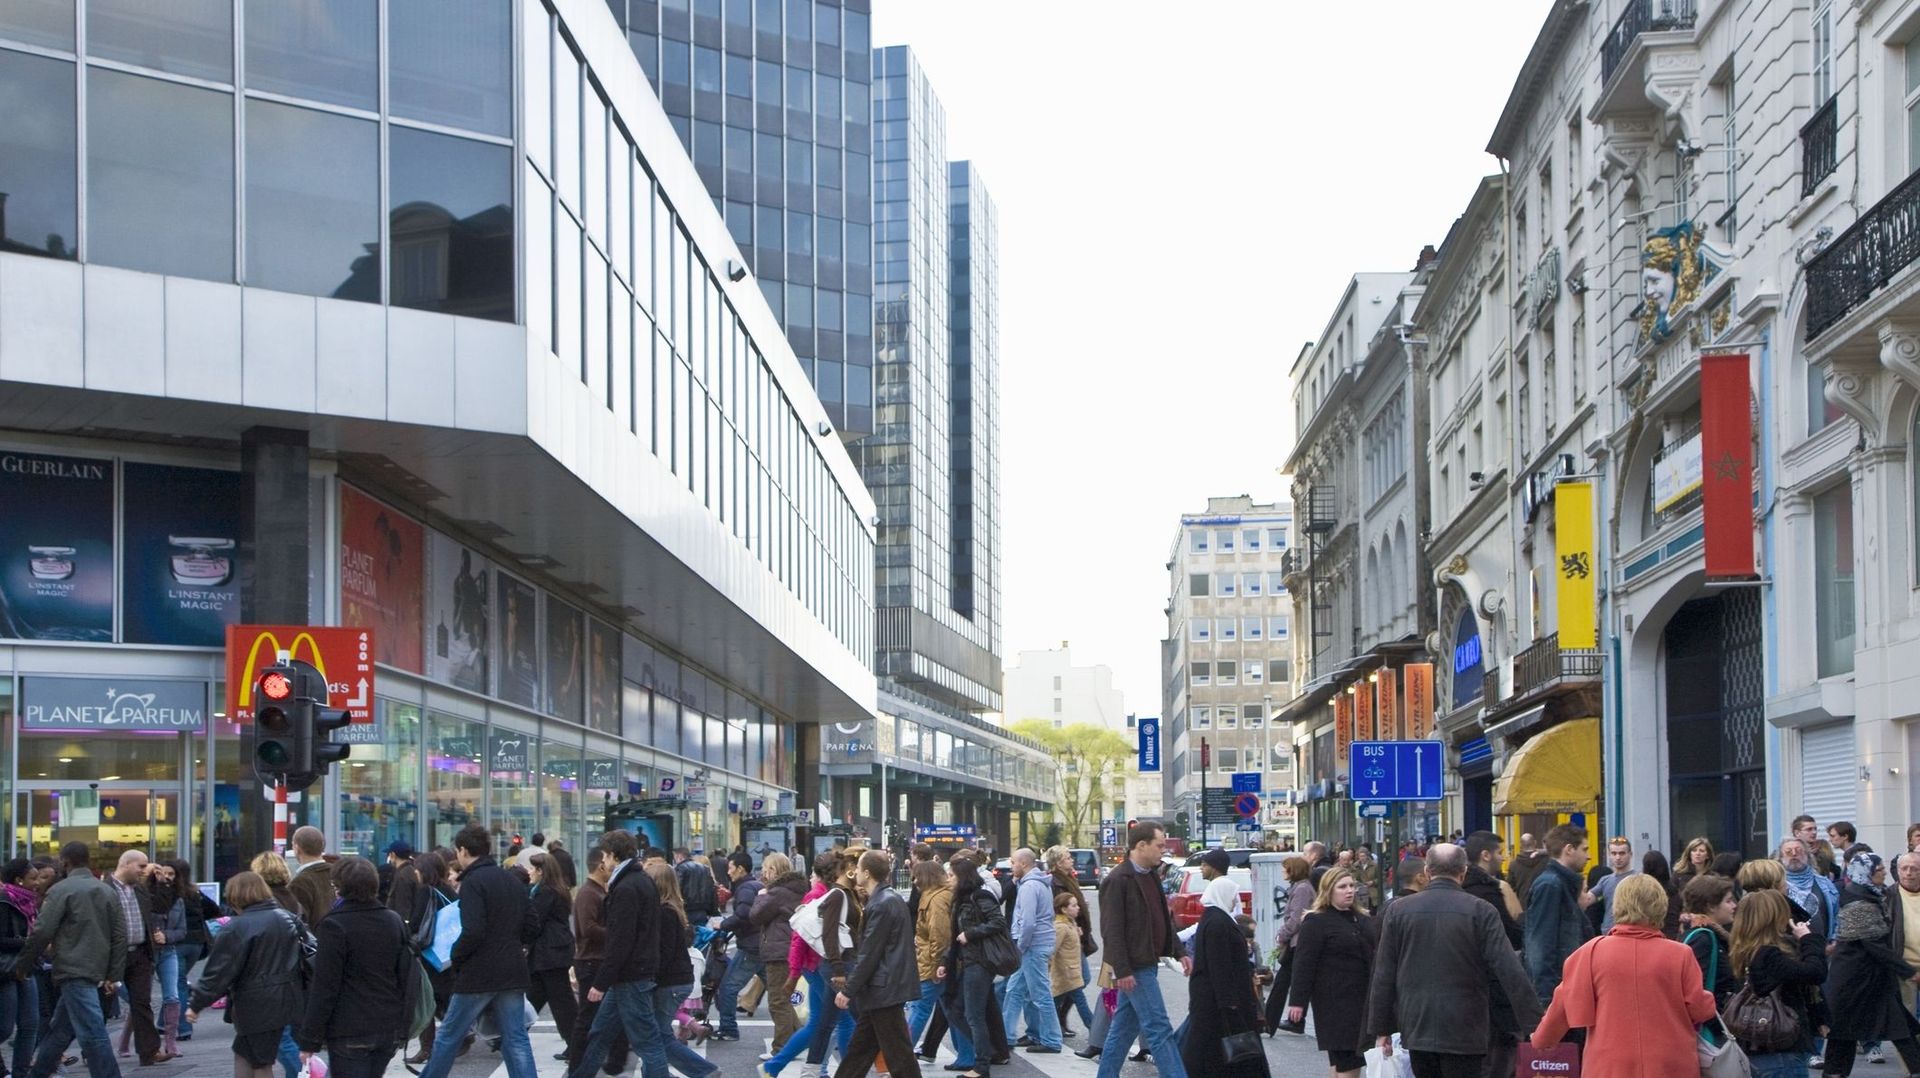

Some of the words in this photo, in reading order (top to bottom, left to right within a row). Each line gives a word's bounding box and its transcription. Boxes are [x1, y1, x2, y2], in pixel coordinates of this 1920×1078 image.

[2, 455, 103, 479] GUERLAIN
[342, 544, 374, 576] PLANET
[28, 582, 75, 590] L'INSTANT
[342, 566, 377, 600] PARFUM
[36, 589, 67, 597] MAGIC
[168, 589, 235, 601] L'INSTANT
[180, 600, 223, 610] MAGIC
[27, 706, 106, 723] PLANET
[122, 707, 202, 725] PARFUM
[338, 724, 378, 732] PLANET
[337, 732, 379, 741] PARFUM
[826, 743, 873, 751] PARTENA
[1145, 735, 1154, 765] Allianz
[1363, 746, 1385, 757] BUS
[1103, 828, 1113, 841] P
[1531, 1060, 1569, 1071] Citizen
